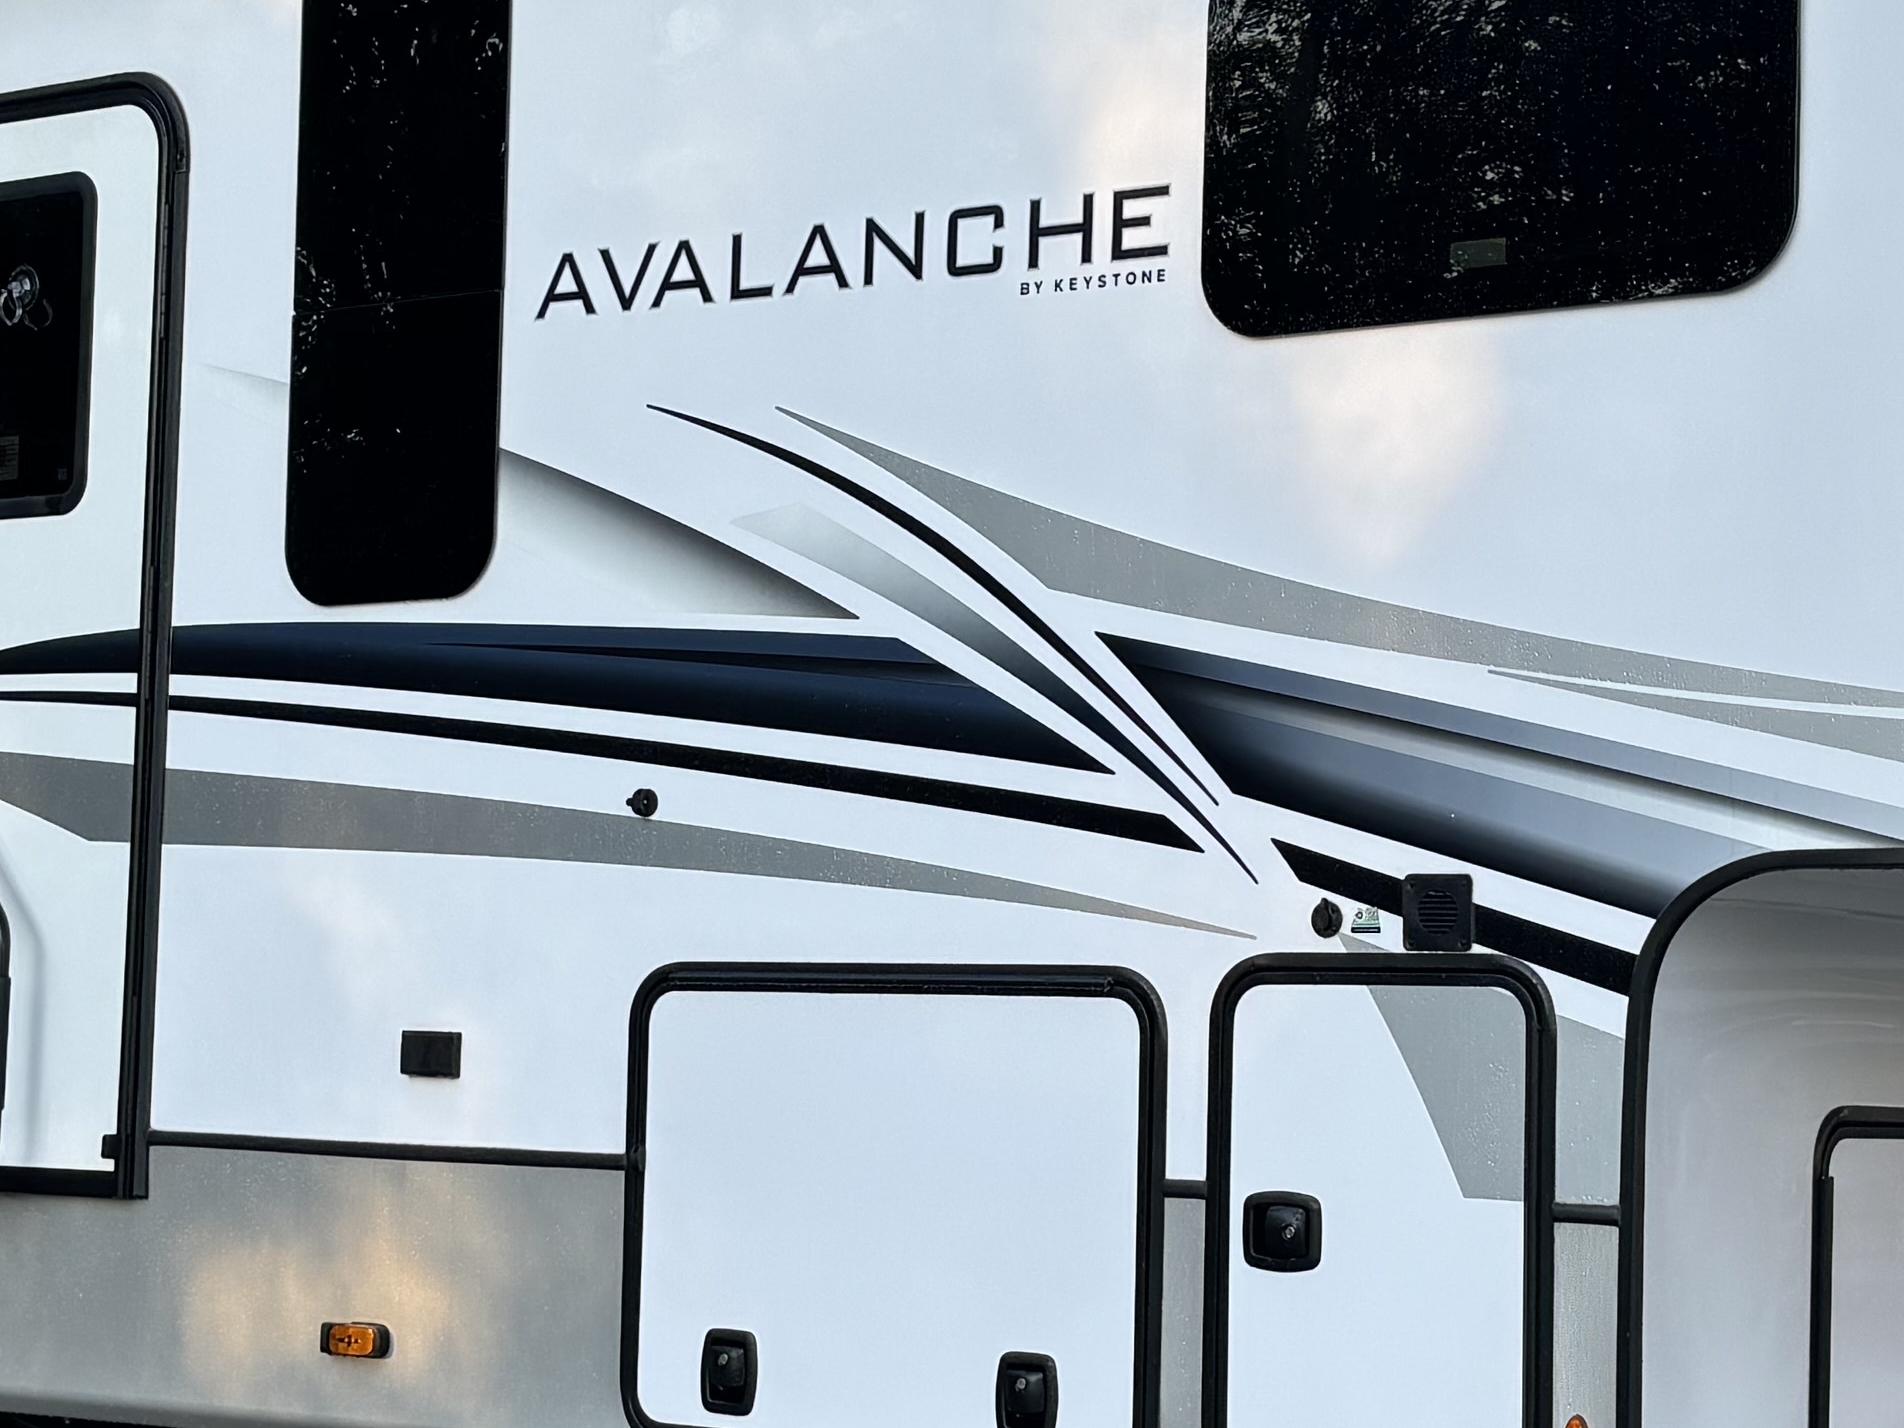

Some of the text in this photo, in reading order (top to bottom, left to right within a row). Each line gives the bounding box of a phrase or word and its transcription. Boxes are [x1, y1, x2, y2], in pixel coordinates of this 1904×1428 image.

[534, 182, 1172, 321] AVALANCHE
[1019, 268, 1167, 296] BY KEYSTONE
